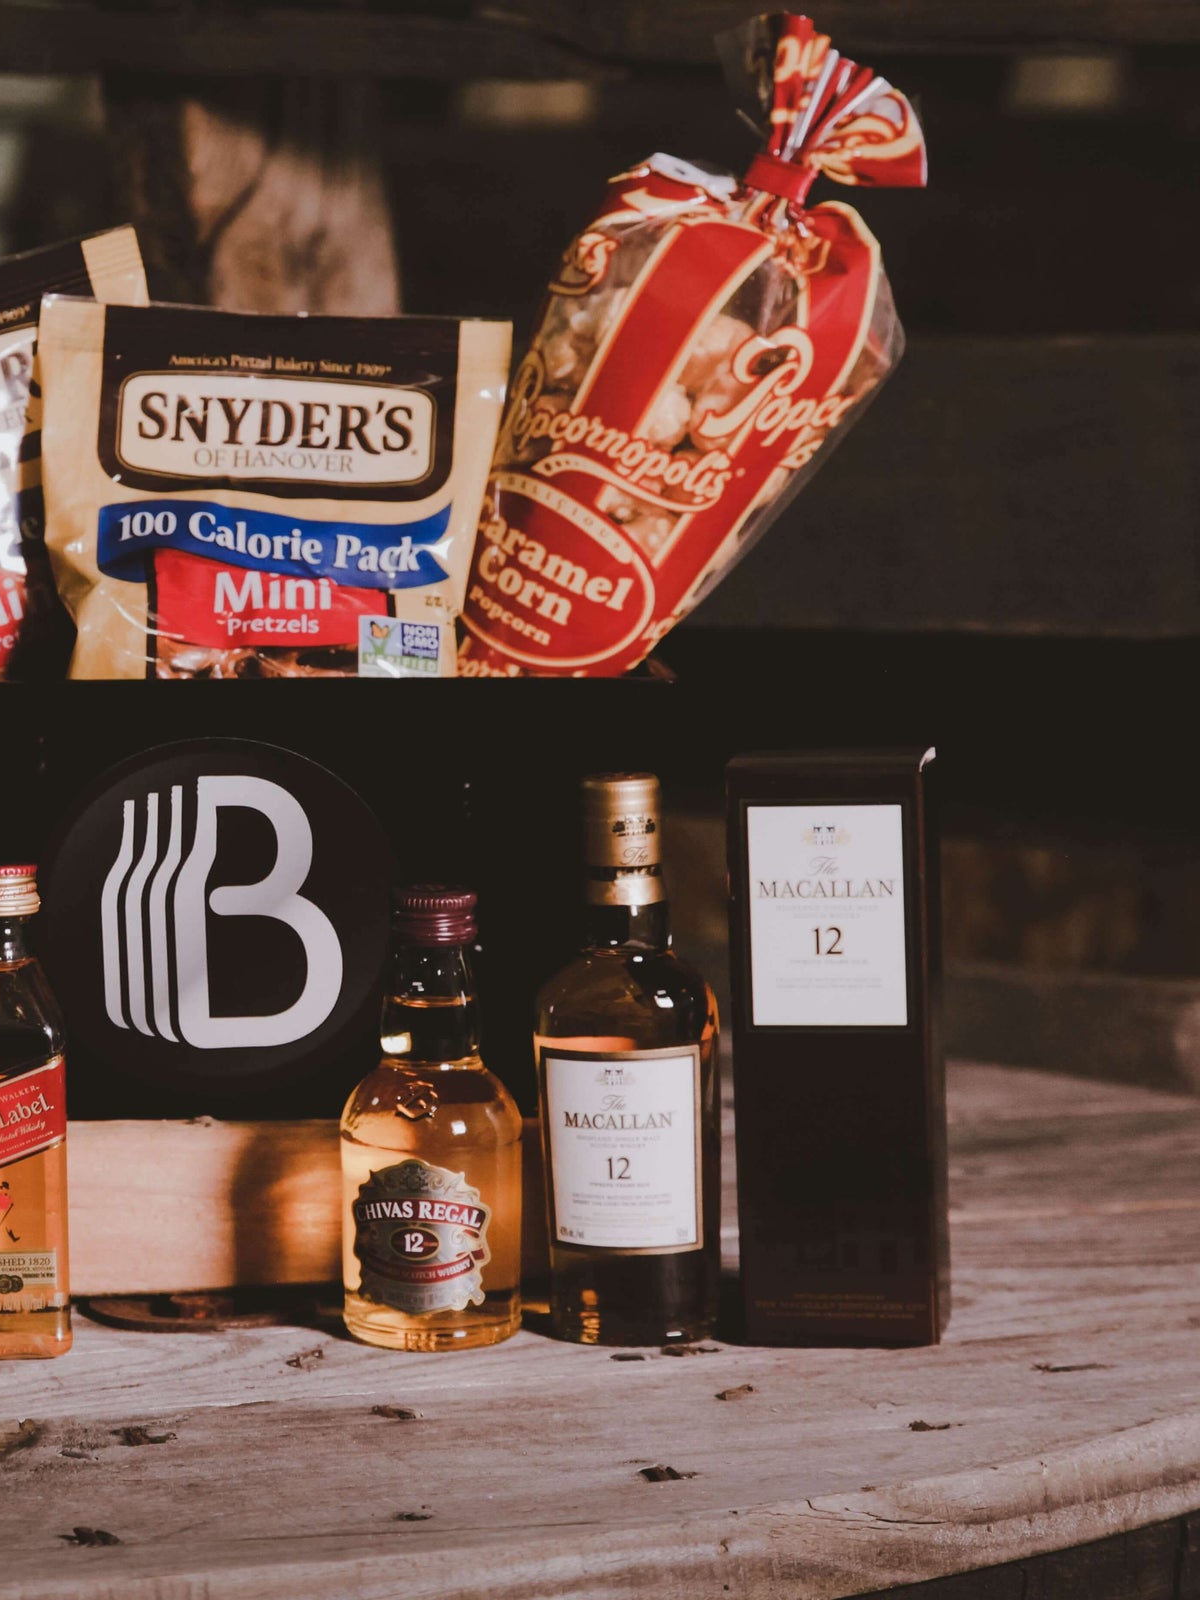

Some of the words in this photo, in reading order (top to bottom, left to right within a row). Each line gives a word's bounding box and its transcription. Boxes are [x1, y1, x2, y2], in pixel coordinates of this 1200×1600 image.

[169, 354, 228, 367] America's
[230, 354, 272, 369] Pretzel
[275, 357, 316, 375] Bakery
[319, 359, 351, 375] Since
[138, 391, 413, 456] SNYDER'S
[498, 350, 731, 502] Popcornopolis
[193, 447, 224, 468] OF
[233, 448, 353, 474] HANOVER
[118, 511, 178, 543] 100
[188, 511, 323, 565] Calorie
[333, 535, 420, 573] Pack
[213, 572, 333, 614] Mini
[479, 545, 572, 626] Corn
[227, 614, 319, 636] Pretzels
[469, 585, 550, 647] Popcorn
[403, 624, 438, 638] NON
[402, 635, 438, 650] GMO
[620, 846, 649, 865] The
[808, 856, 839, 876] The
[759, 880, 895, 898] MACALLAN
[813, 927, 843, 956] 12
[600, 1094, 626, 1112] The
[564, 1111, 674, 1130] MACALLAN
[606, 1157, 631, 1180] 12
[418, 1201, 481, 1228] REGAL
[404, 1232, 424, 1253] 12
[29, 1256, 51, 1266] 1820
